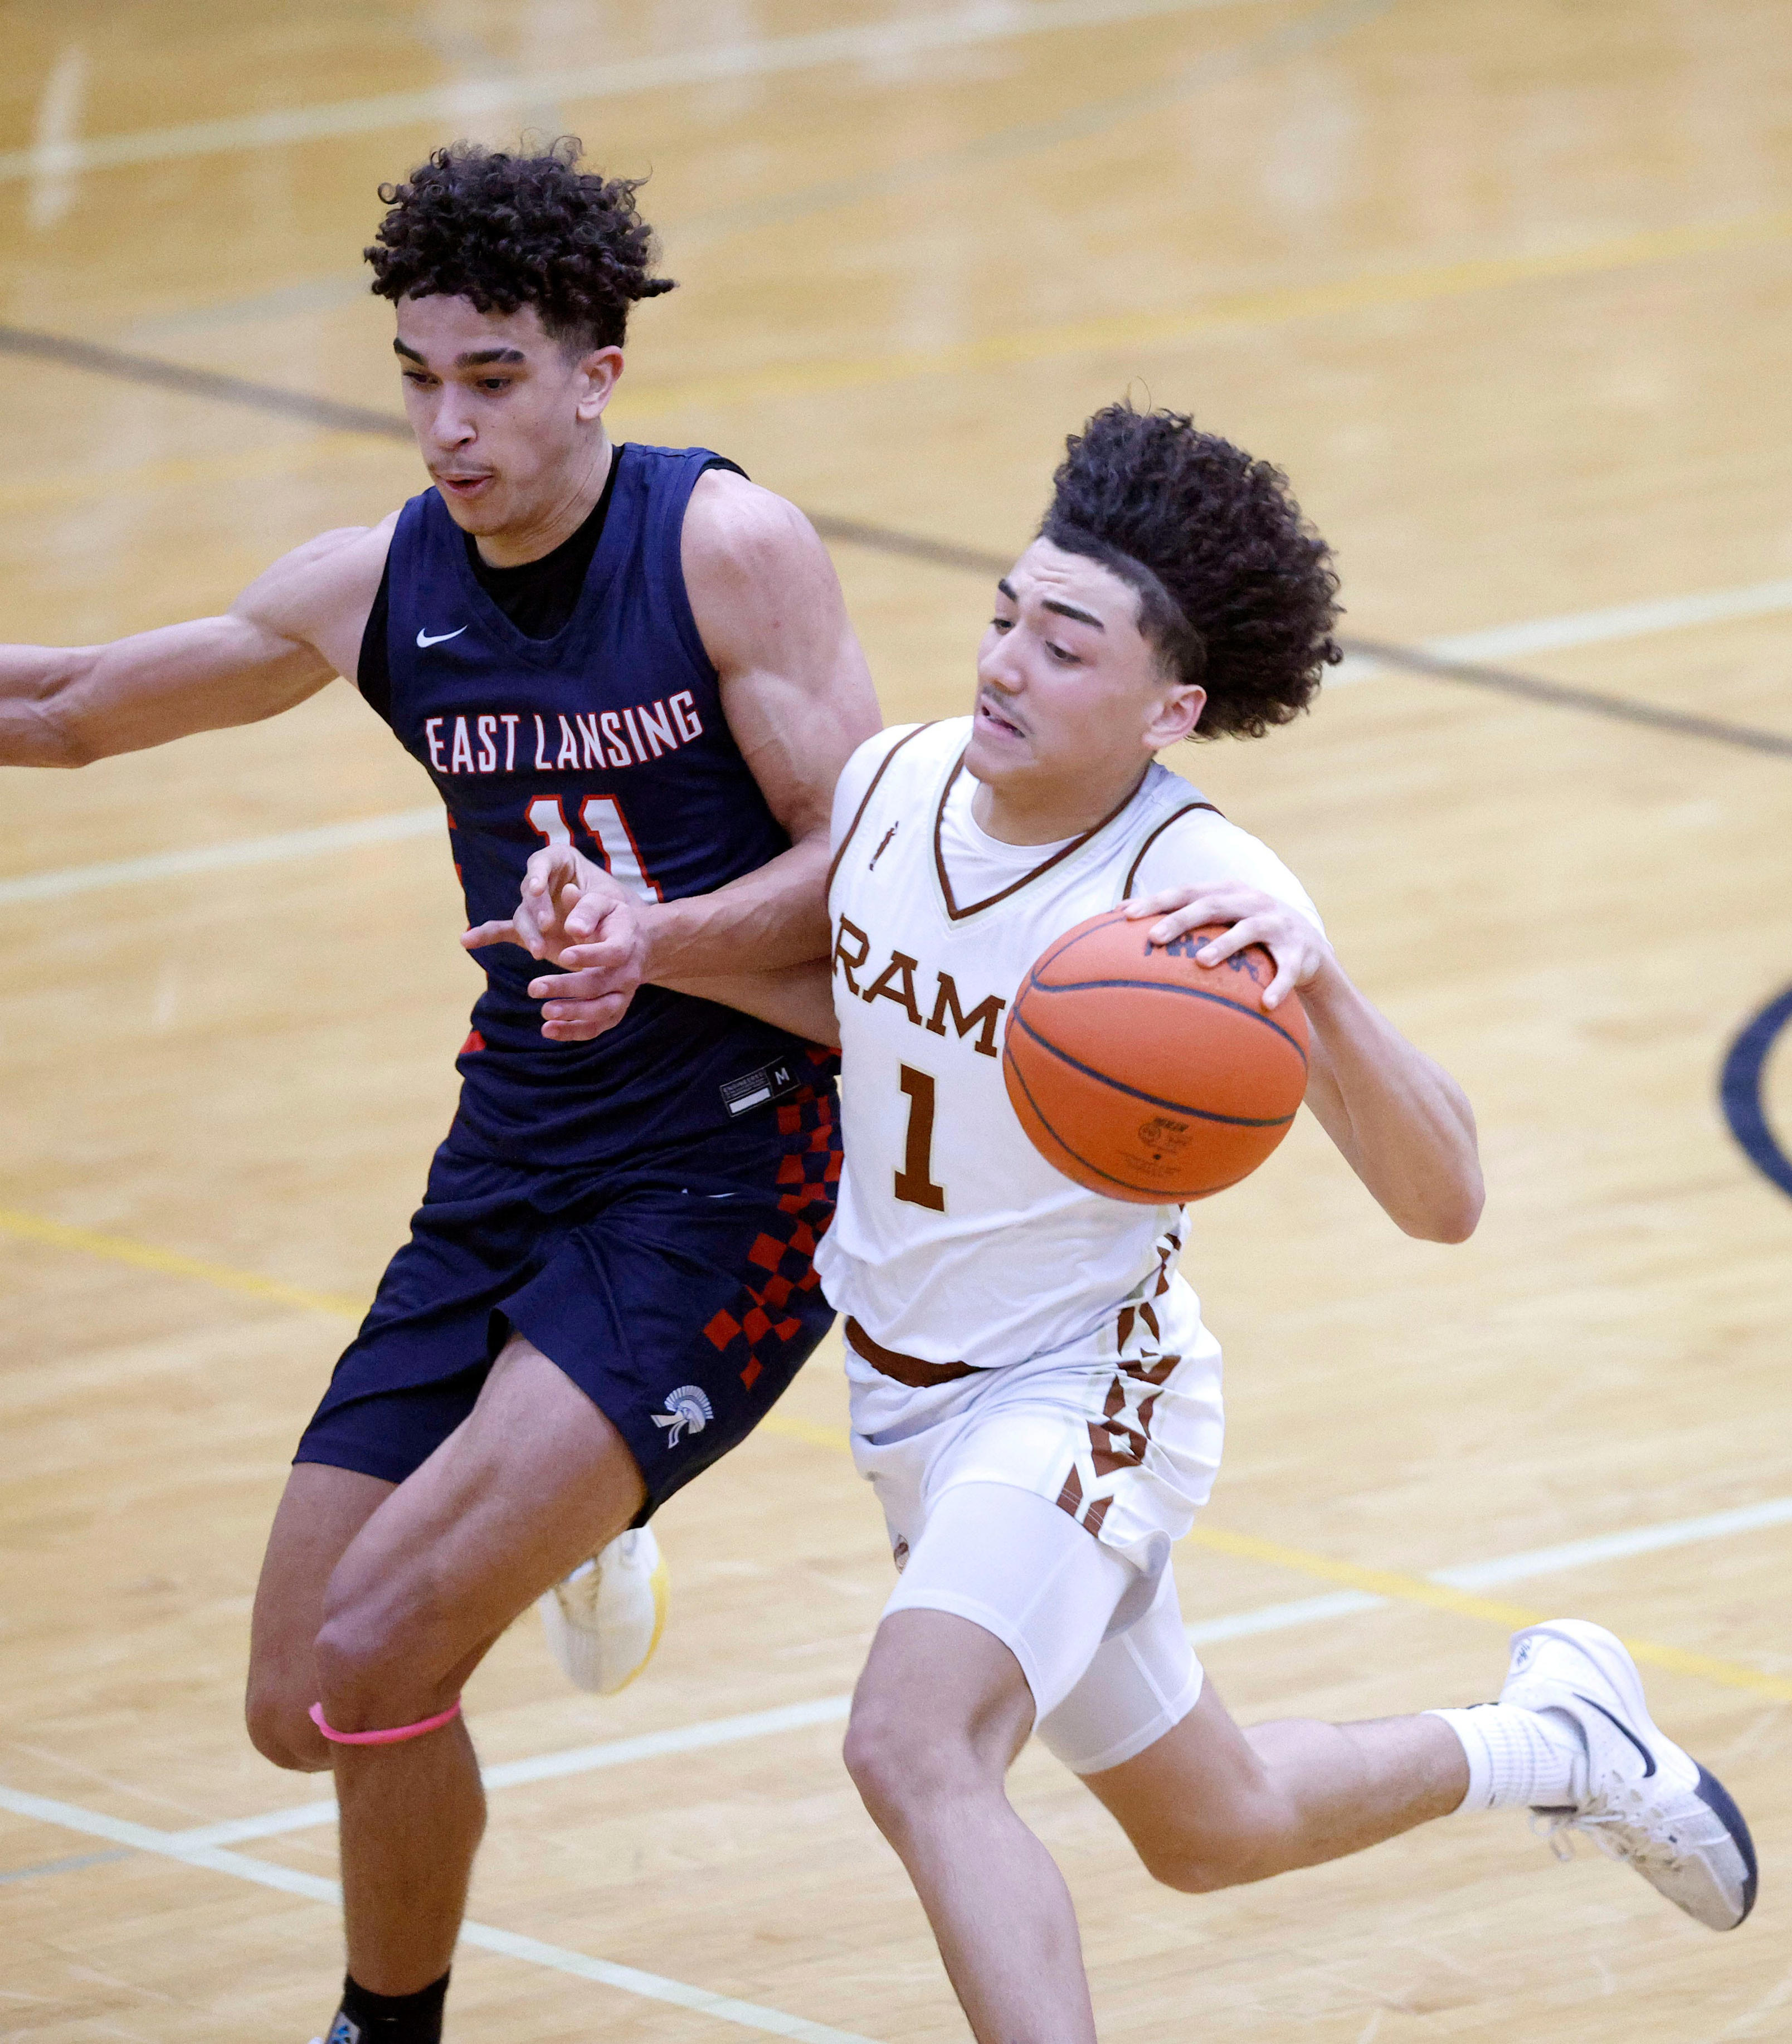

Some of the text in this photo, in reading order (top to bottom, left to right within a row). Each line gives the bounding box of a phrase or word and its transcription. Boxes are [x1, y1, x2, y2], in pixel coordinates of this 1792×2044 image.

[425, 689, 704, 774] EAST LANSING
[775, 1067, 790, 1085] M
[894, 1063, 945, 1212] 1
